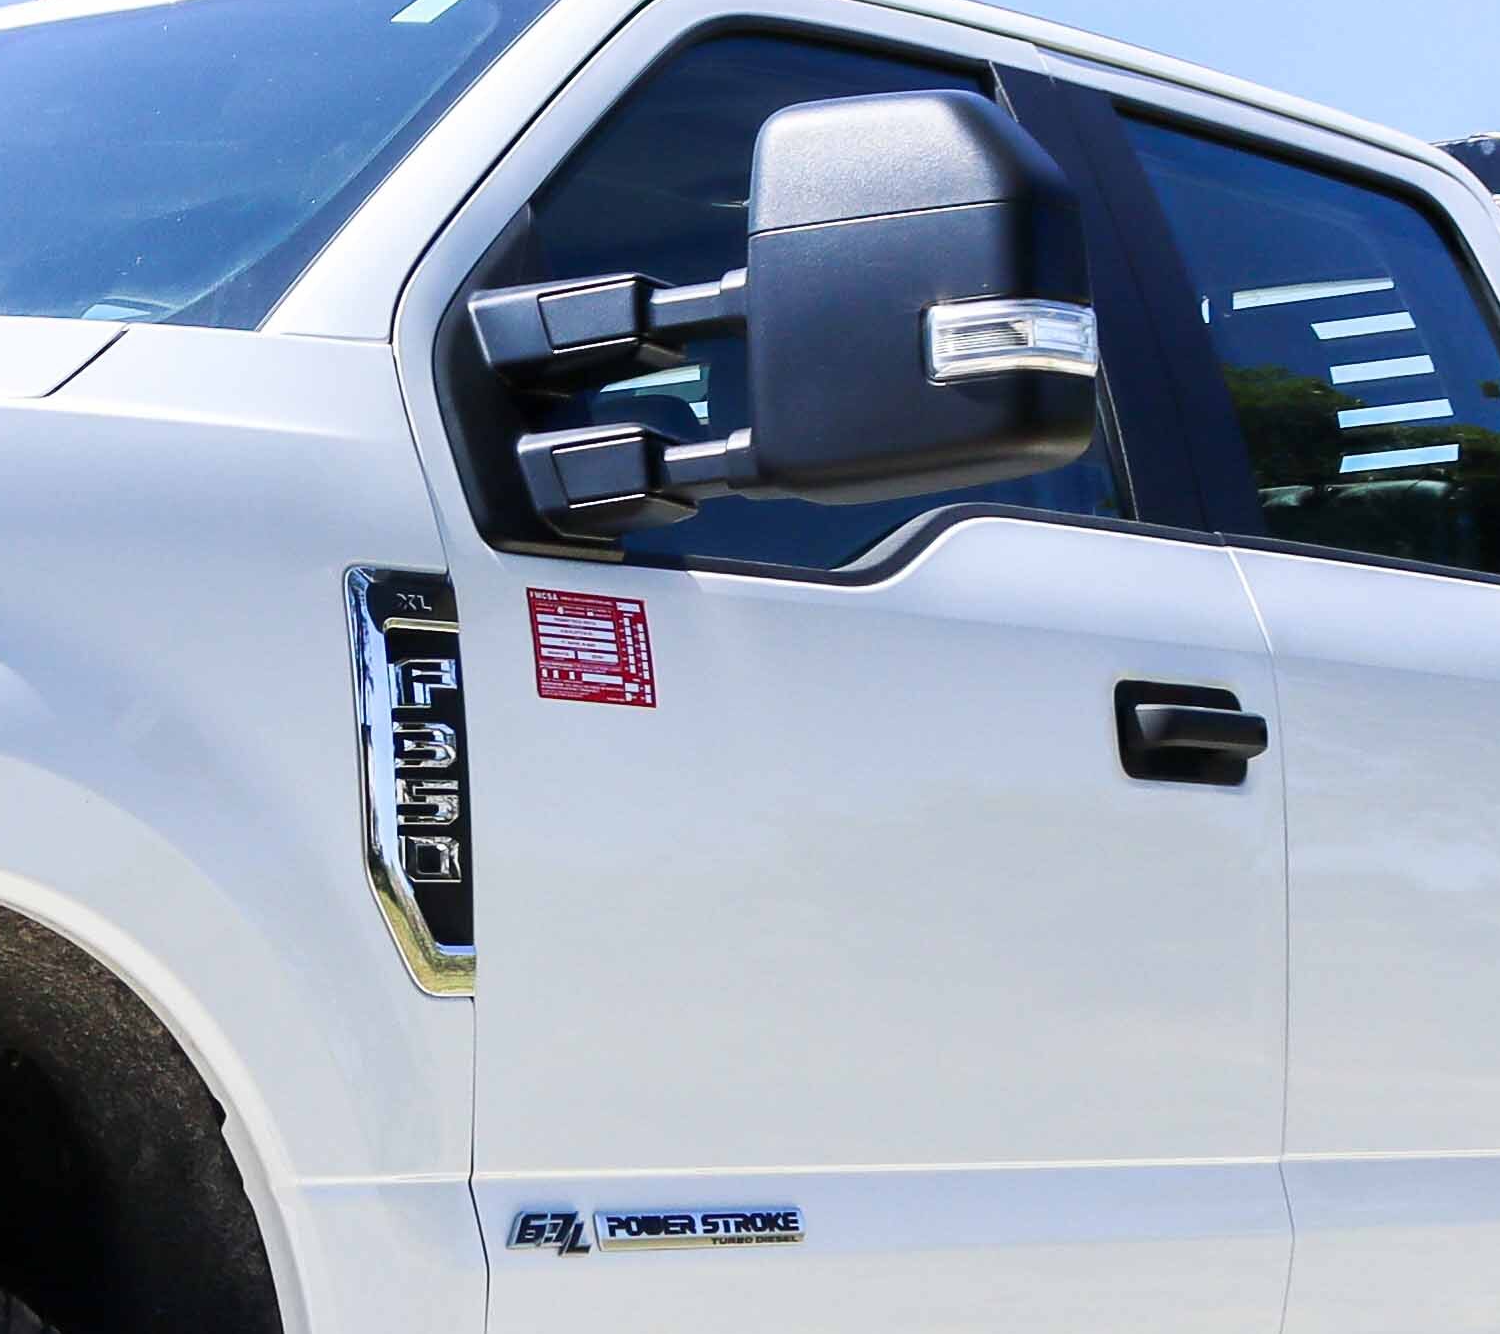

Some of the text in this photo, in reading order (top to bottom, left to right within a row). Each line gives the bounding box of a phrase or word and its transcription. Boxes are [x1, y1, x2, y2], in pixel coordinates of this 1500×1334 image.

[395, 592, 433, 612] XL
[606, 1212, 800, 1237] POWER STROKE
[711, 1235, 799, 1245] TURBO DIESEL
